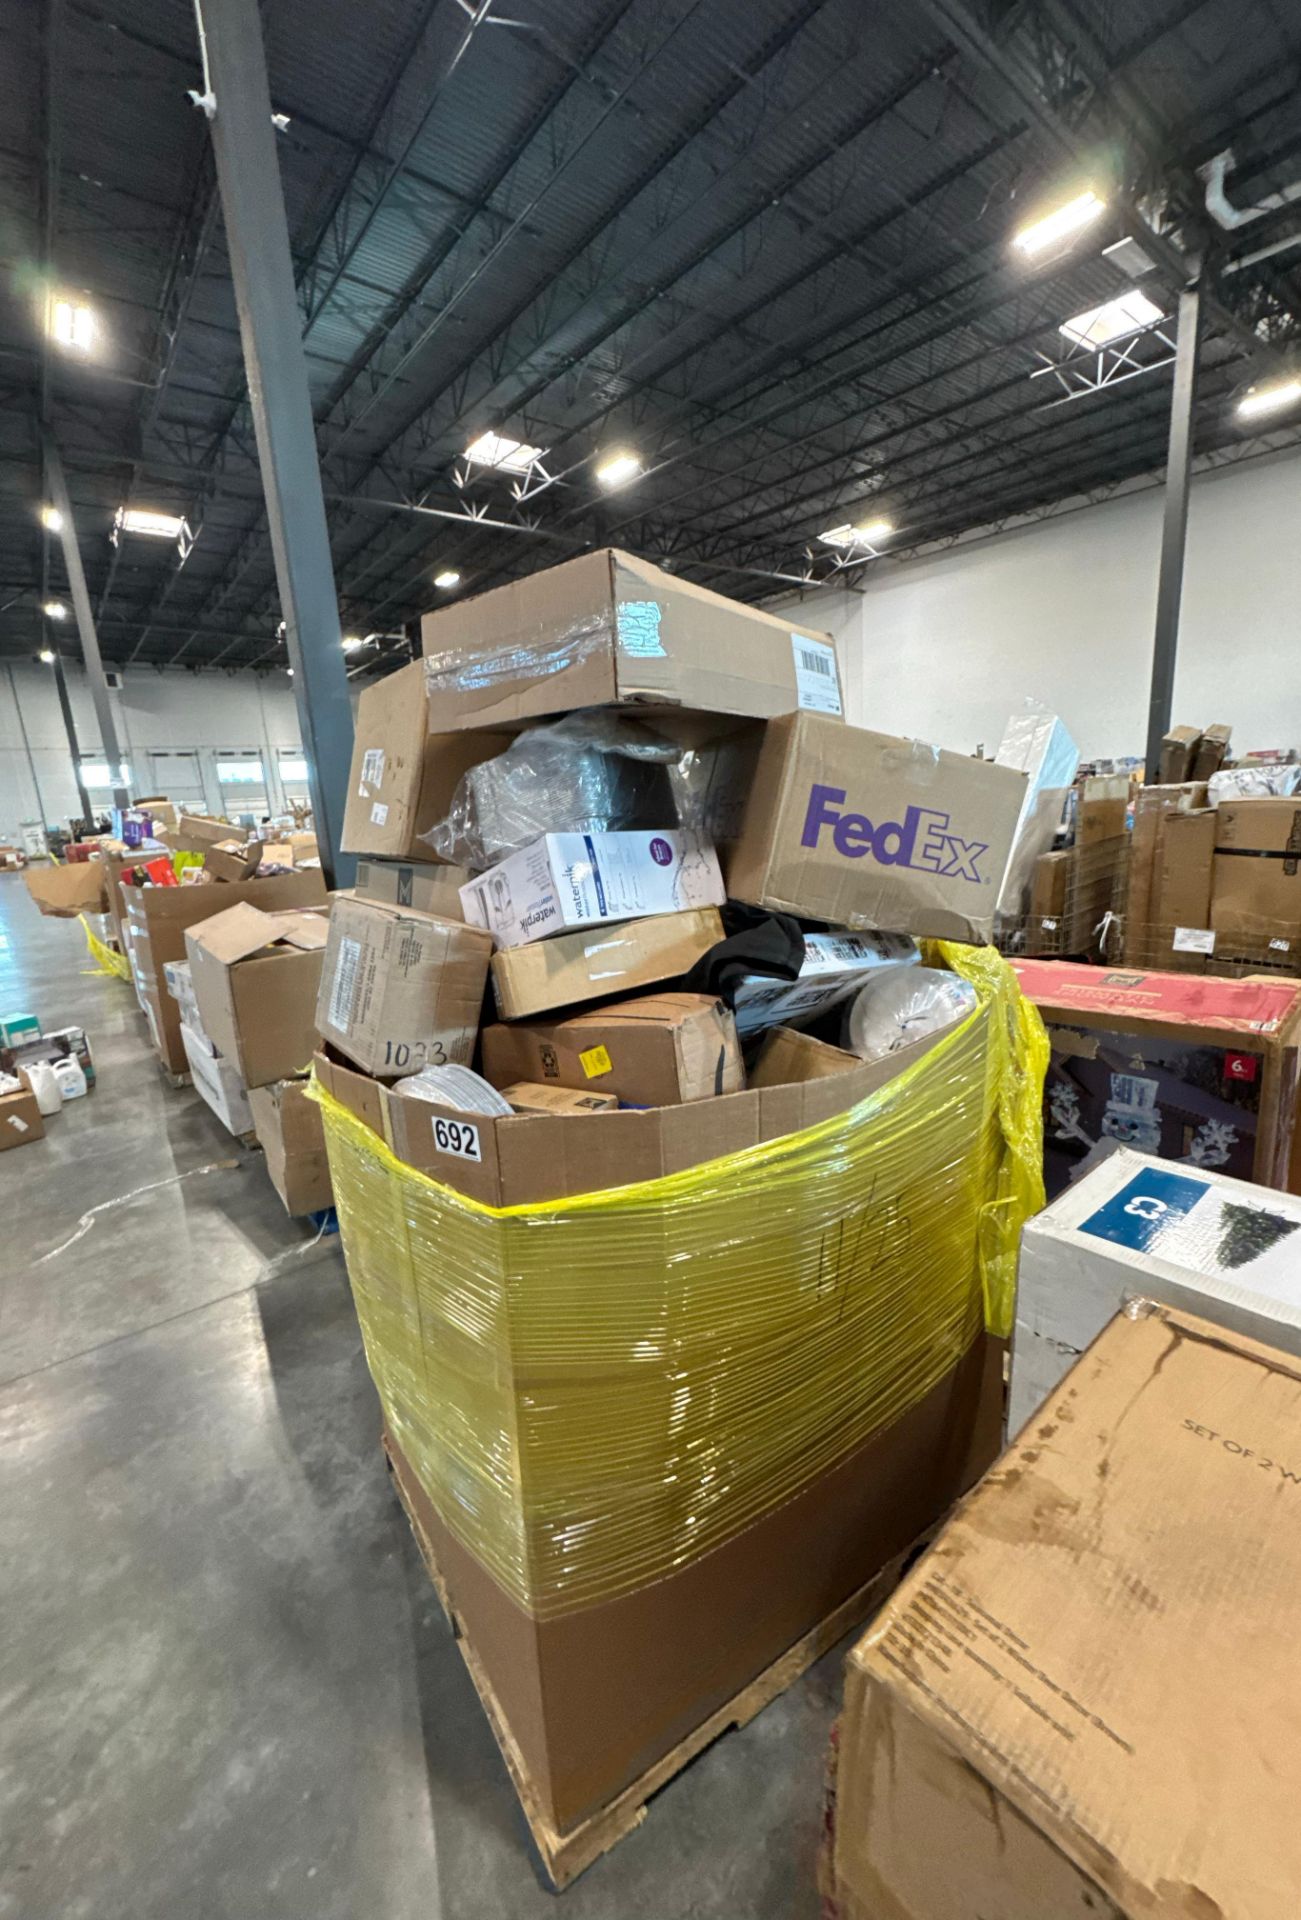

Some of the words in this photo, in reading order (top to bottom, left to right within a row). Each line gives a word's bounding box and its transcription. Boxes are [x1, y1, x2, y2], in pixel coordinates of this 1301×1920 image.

[801, 784, 989, 883] FedEx
[520, 906, 556, 938] waterpik
[1231, 1060, 1242, 1072] 6
[435, 1119, 477, 1156] 692
[1181, 1419, 1220, 1440] SET
[1223, 1440, 1255, 1458] OF
[1257, 1458, 1273, 1471] 2
